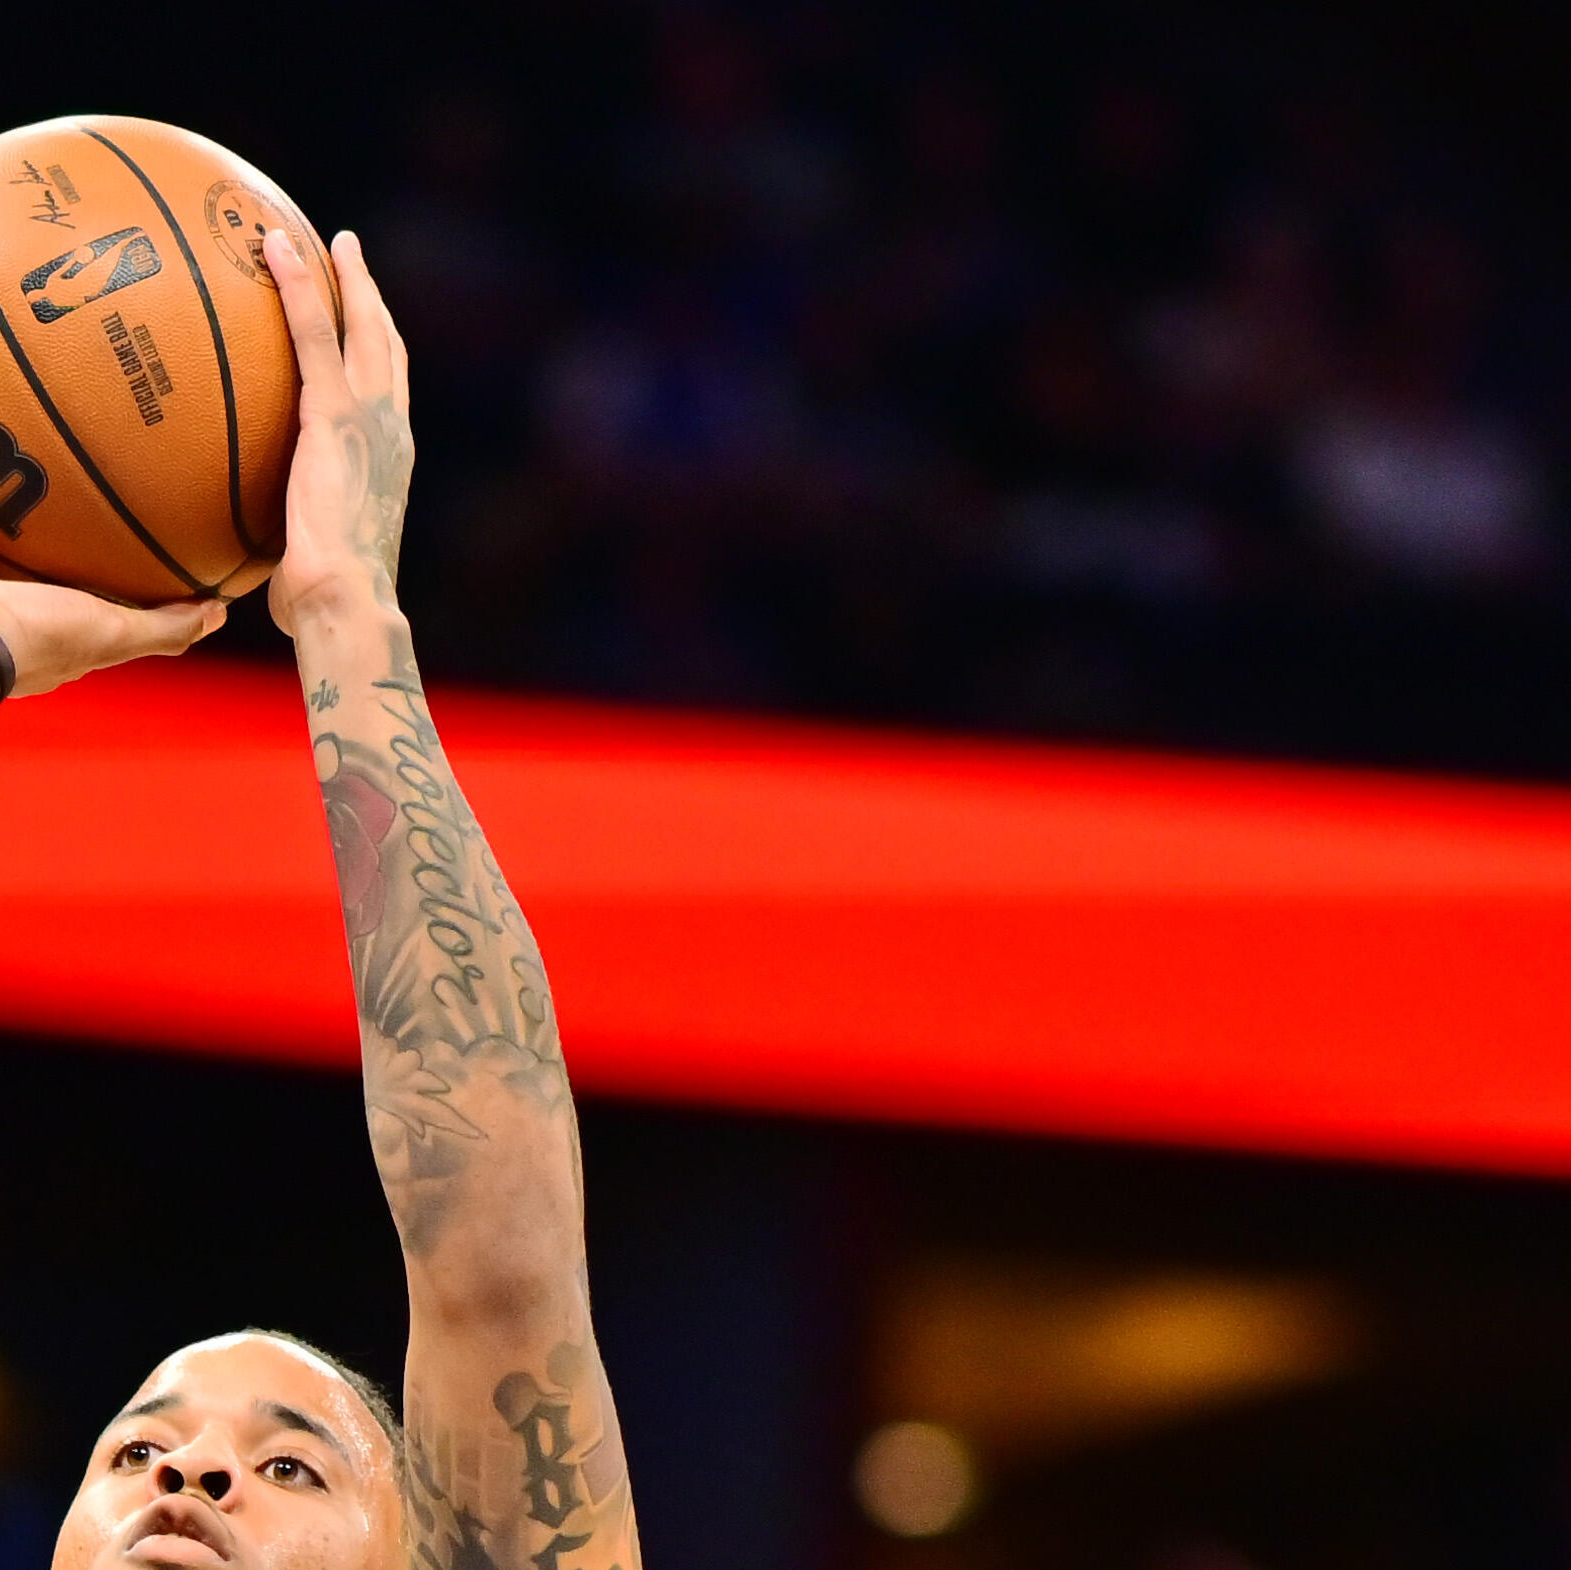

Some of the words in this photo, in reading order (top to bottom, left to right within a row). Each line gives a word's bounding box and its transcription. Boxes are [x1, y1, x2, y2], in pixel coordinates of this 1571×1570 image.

[127, 243, 157, 274] NBA
[100, 311, 128, 344] BALL
[113, 339, 143, 376] GAME
[128, 372, 164, 427] OFFICIAL
